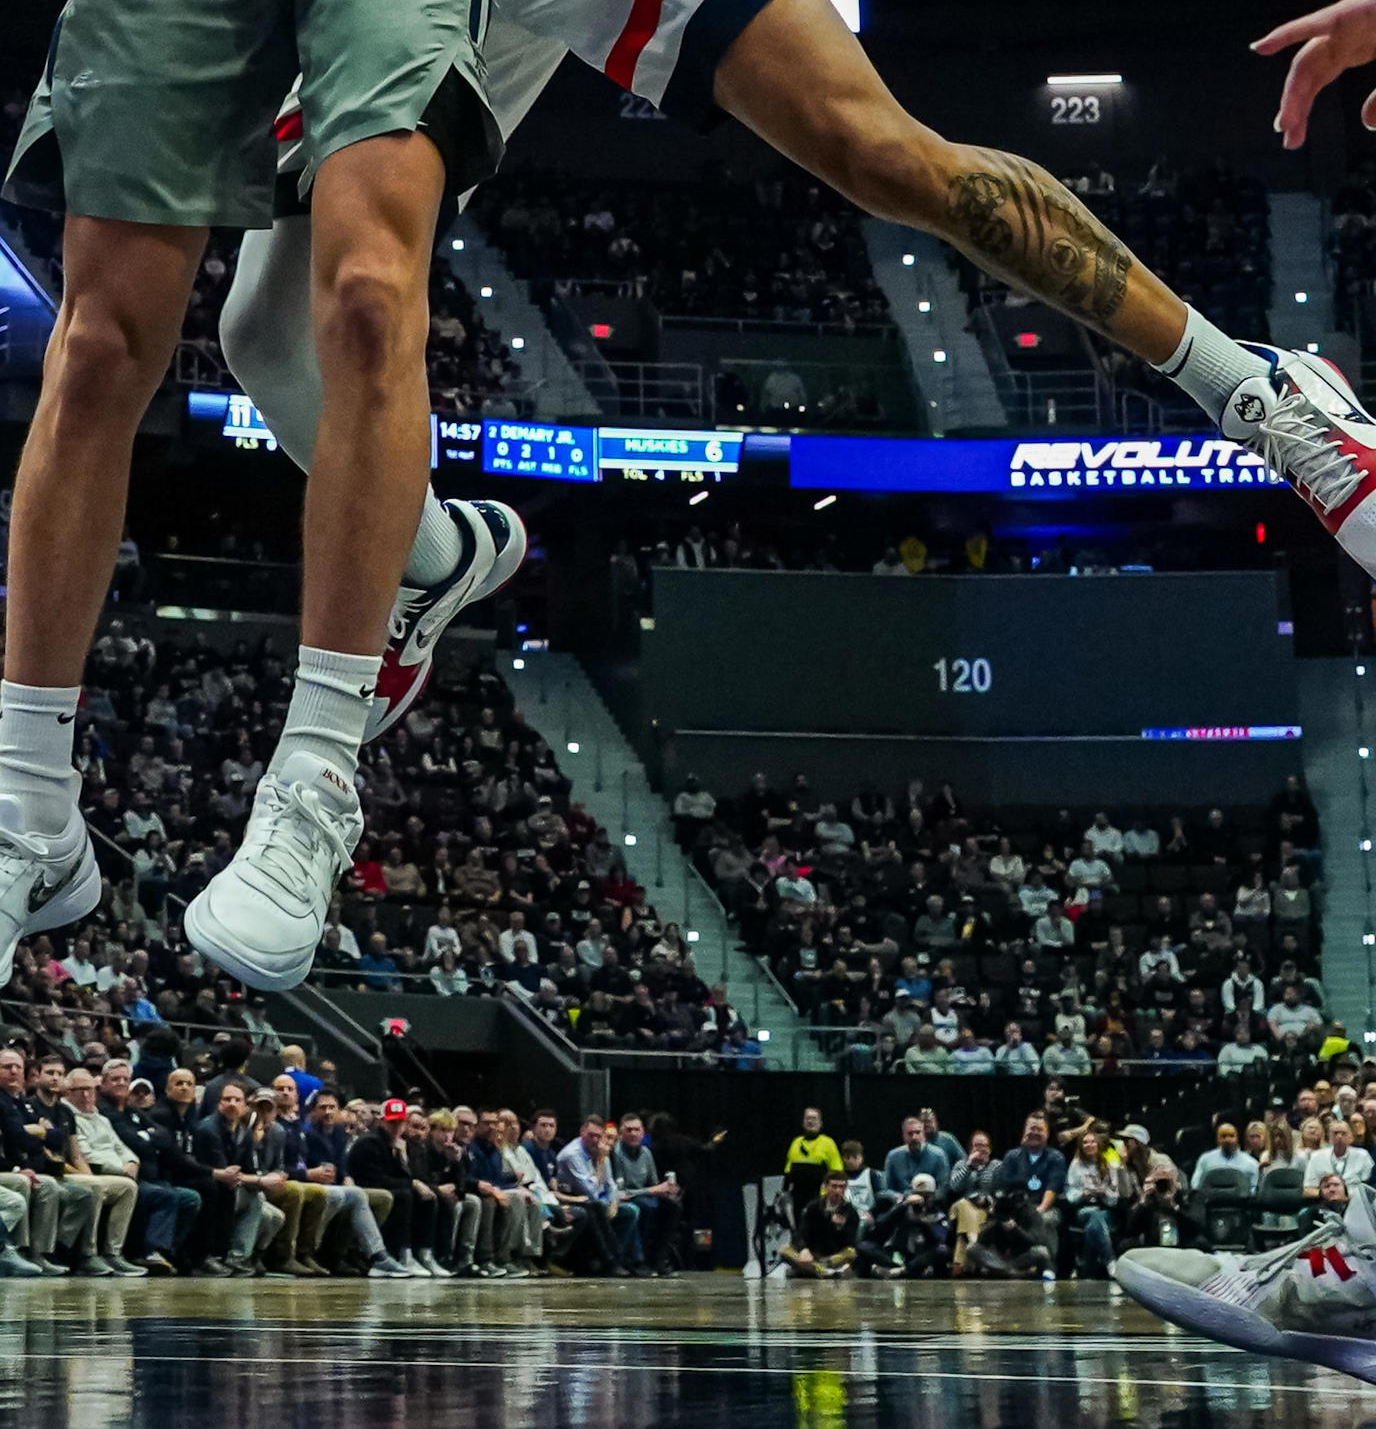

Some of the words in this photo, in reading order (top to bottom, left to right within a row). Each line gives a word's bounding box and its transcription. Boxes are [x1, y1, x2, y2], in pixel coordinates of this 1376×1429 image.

[1051, 96, 1100, 125] 223
[439, 422, 481, 441] 14:57
[500, 425, 554, 443] DEMARY
[496, 441, 509, 456] 0
[521, 443, 532, 459] 2
[547, 446, 556, 459] 1
[570, 448, 584, 463] 0
[624, 438, 689, 454] HUSKIES
[704, 440, 724, 463] 6
[1009, 440, 1265, 470] REVOLUT
[1009, 468, 1191, 487] BASKETBALL
[1200, 467, 1284, 484] TRAI
[933, 657, 993, 693] 120
